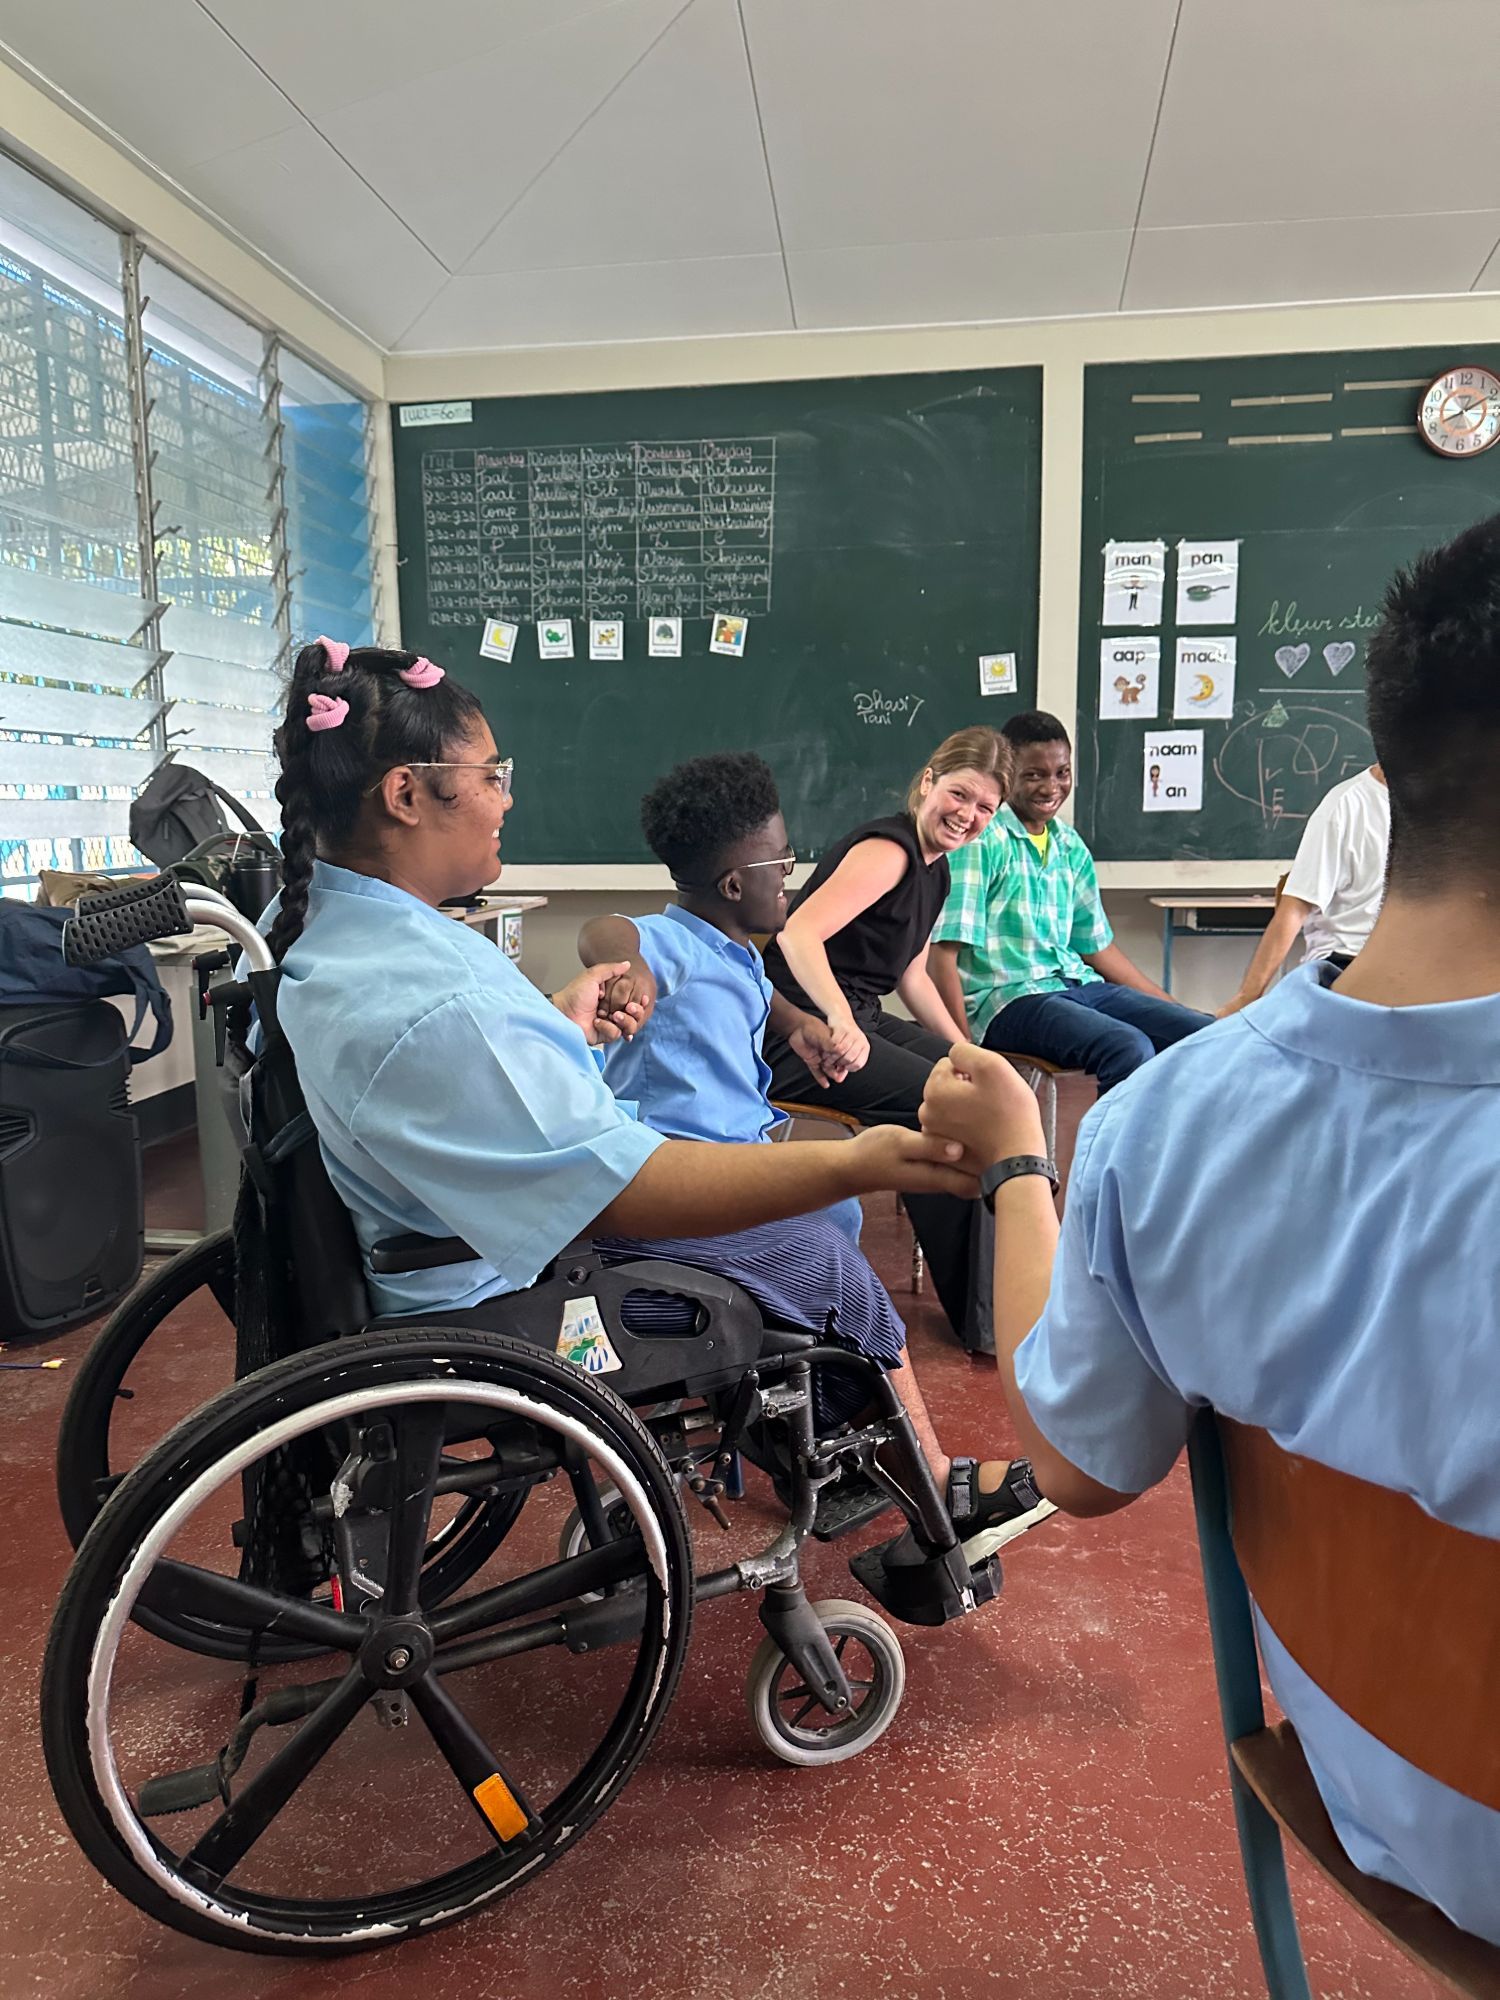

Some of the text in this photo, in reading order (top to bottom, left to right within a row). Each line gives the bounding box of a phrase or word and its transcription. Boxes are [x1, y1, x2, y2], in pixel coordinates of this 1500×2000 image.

[1444, 377, 1453, 389] 11
[1460, 372, 1473, 385] 12
[1481, 376, 1485, 389] 1
[1430, 389, 1442, 402] 10
[1489, 388, 1498, 401] 2
[1425, 406, 1434, 419] 9
[1428, 422, 1437, 435] 8
[1440, 435, 1448, 447] 7
[1456, 439, 1465, 451] 6
[1473, 434, 1482, 447] 5
[1115, 554, 1152, 566] man
[1190, 552, 1223, 567] pan
[1258, 600, 1332, 636] kleur
[1114, 650, 1146, 663] aap
[1149, 743, 1198, 757] naam
[1166, 785, 1188, 798] an
